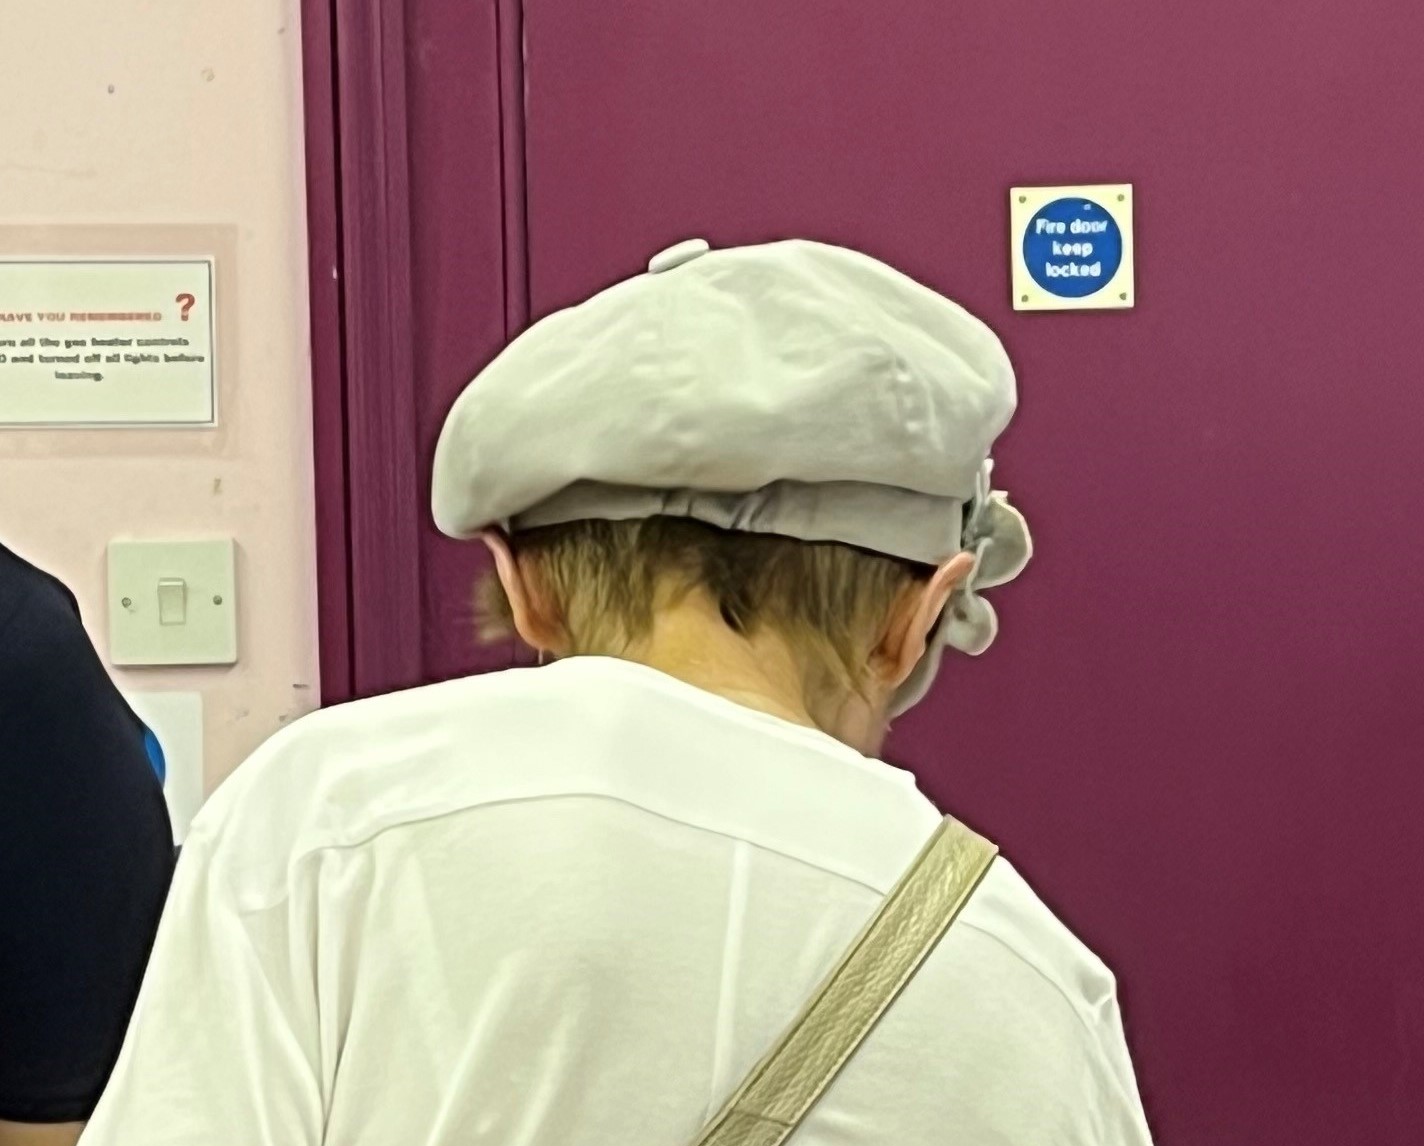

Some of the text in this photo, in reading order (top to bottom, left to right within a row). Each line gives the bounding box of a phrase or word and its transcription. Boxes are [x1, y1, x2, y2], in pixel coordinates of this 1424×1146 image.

[1035, 218, 1108, 235] Fire door
[1052, 240, 1093, 258] keep
[1045, 261, 1101, 278] locked
[37, 312, 65, 322] YOU
[39, 338, 60, 347] the
[124, 353, 160, 365] lights
[164, 353, 205, 363] before
